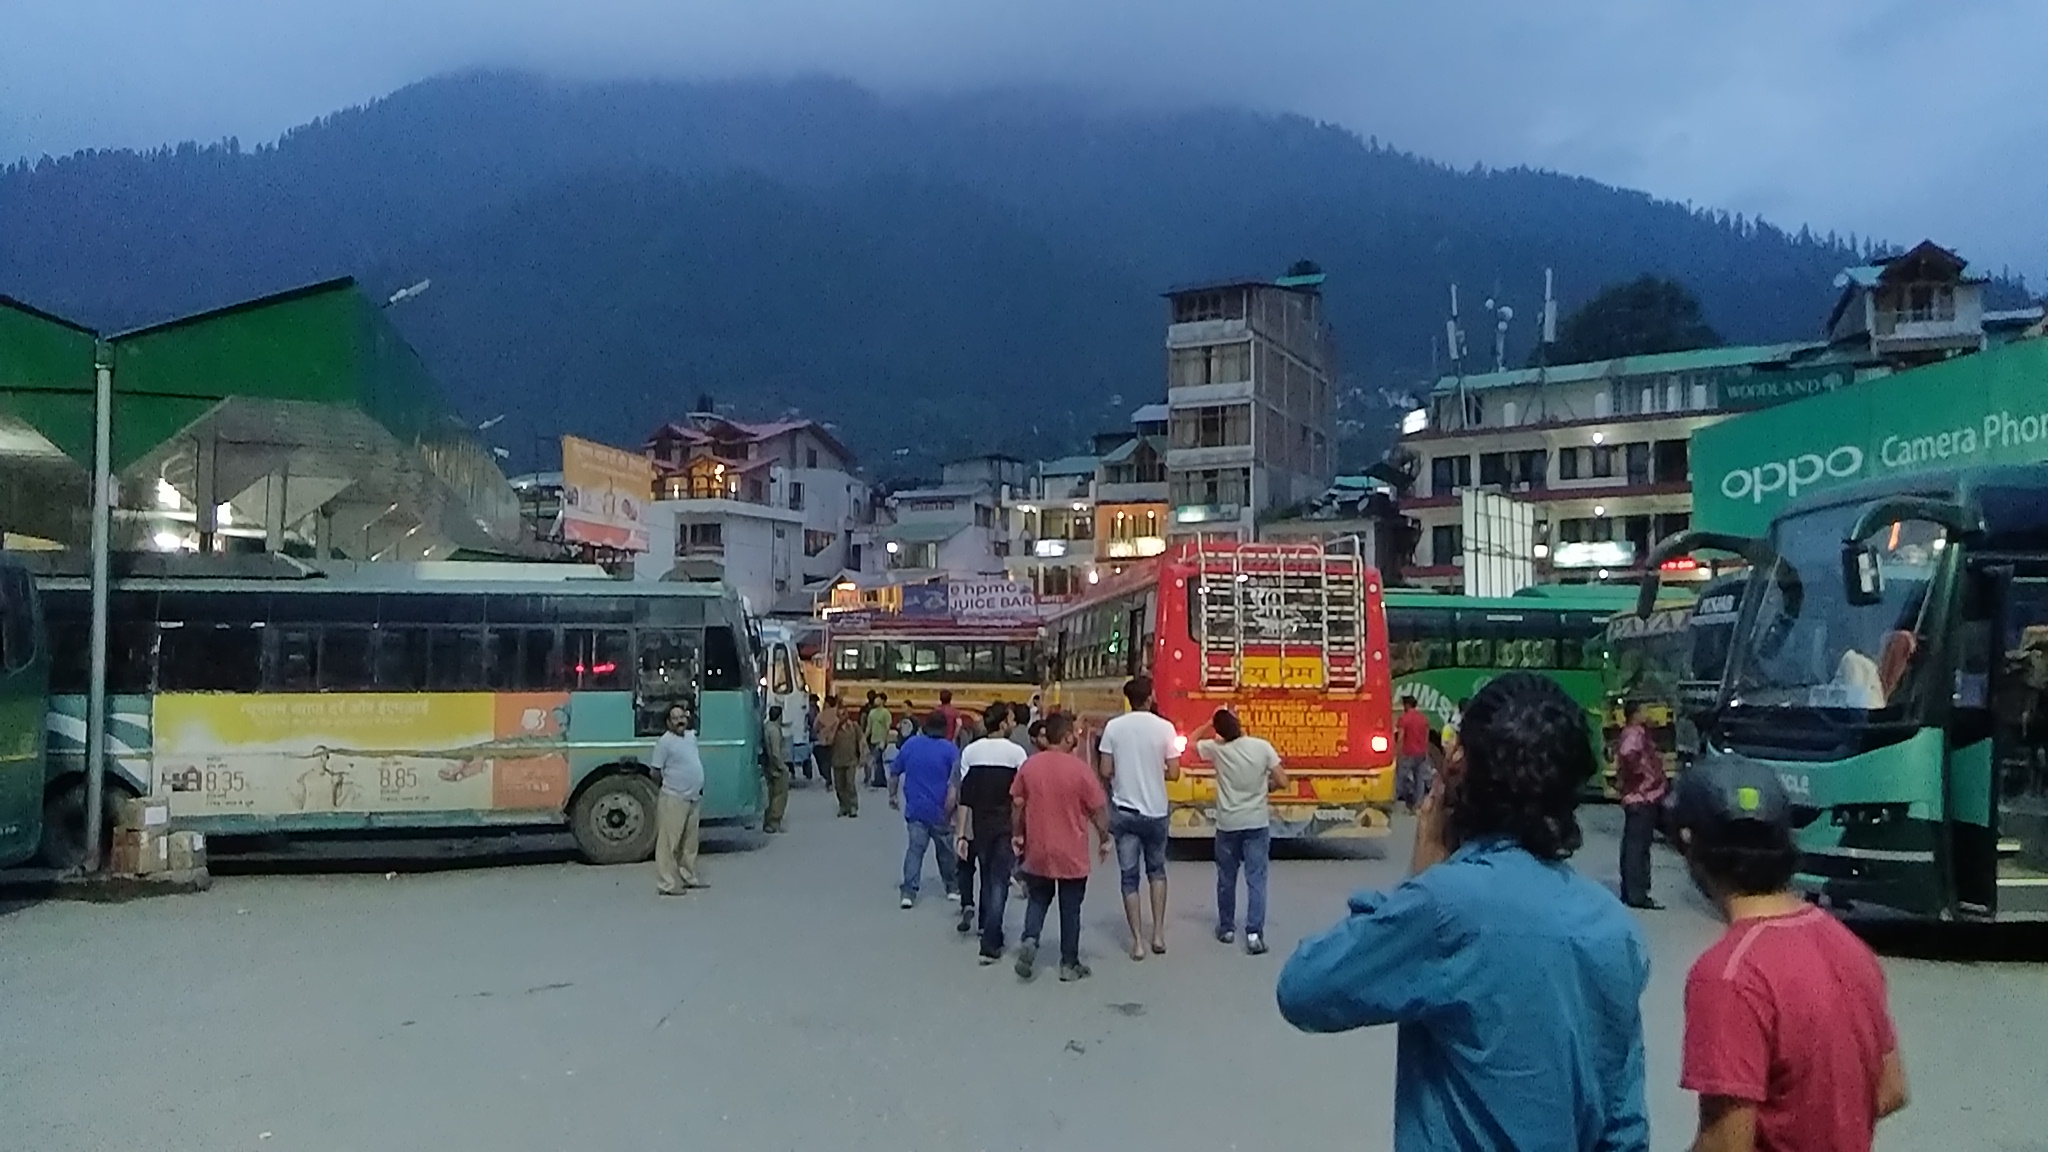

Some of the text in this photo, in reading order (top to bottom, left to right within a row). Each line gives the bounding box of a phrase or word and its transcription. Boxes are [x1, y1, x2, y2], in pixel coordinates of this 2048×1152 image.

[1726, 378, 1820, 399] WOODLAND
[1720, 445, 1864, 504] oppo
[1881, 426, 1977, 468] Camera
[964, 583, 1017, 598] hpmc
[950, 597, 996, 611] JUICE
[1000, 595, 1033, 608] BAR
[1393, 681, 1455, 724] HIMS
[1255, 711, 1279, 727] LALA
[1306, 711, 1338, 727] CHAND
[1339, 711, 1349, 727] JI
